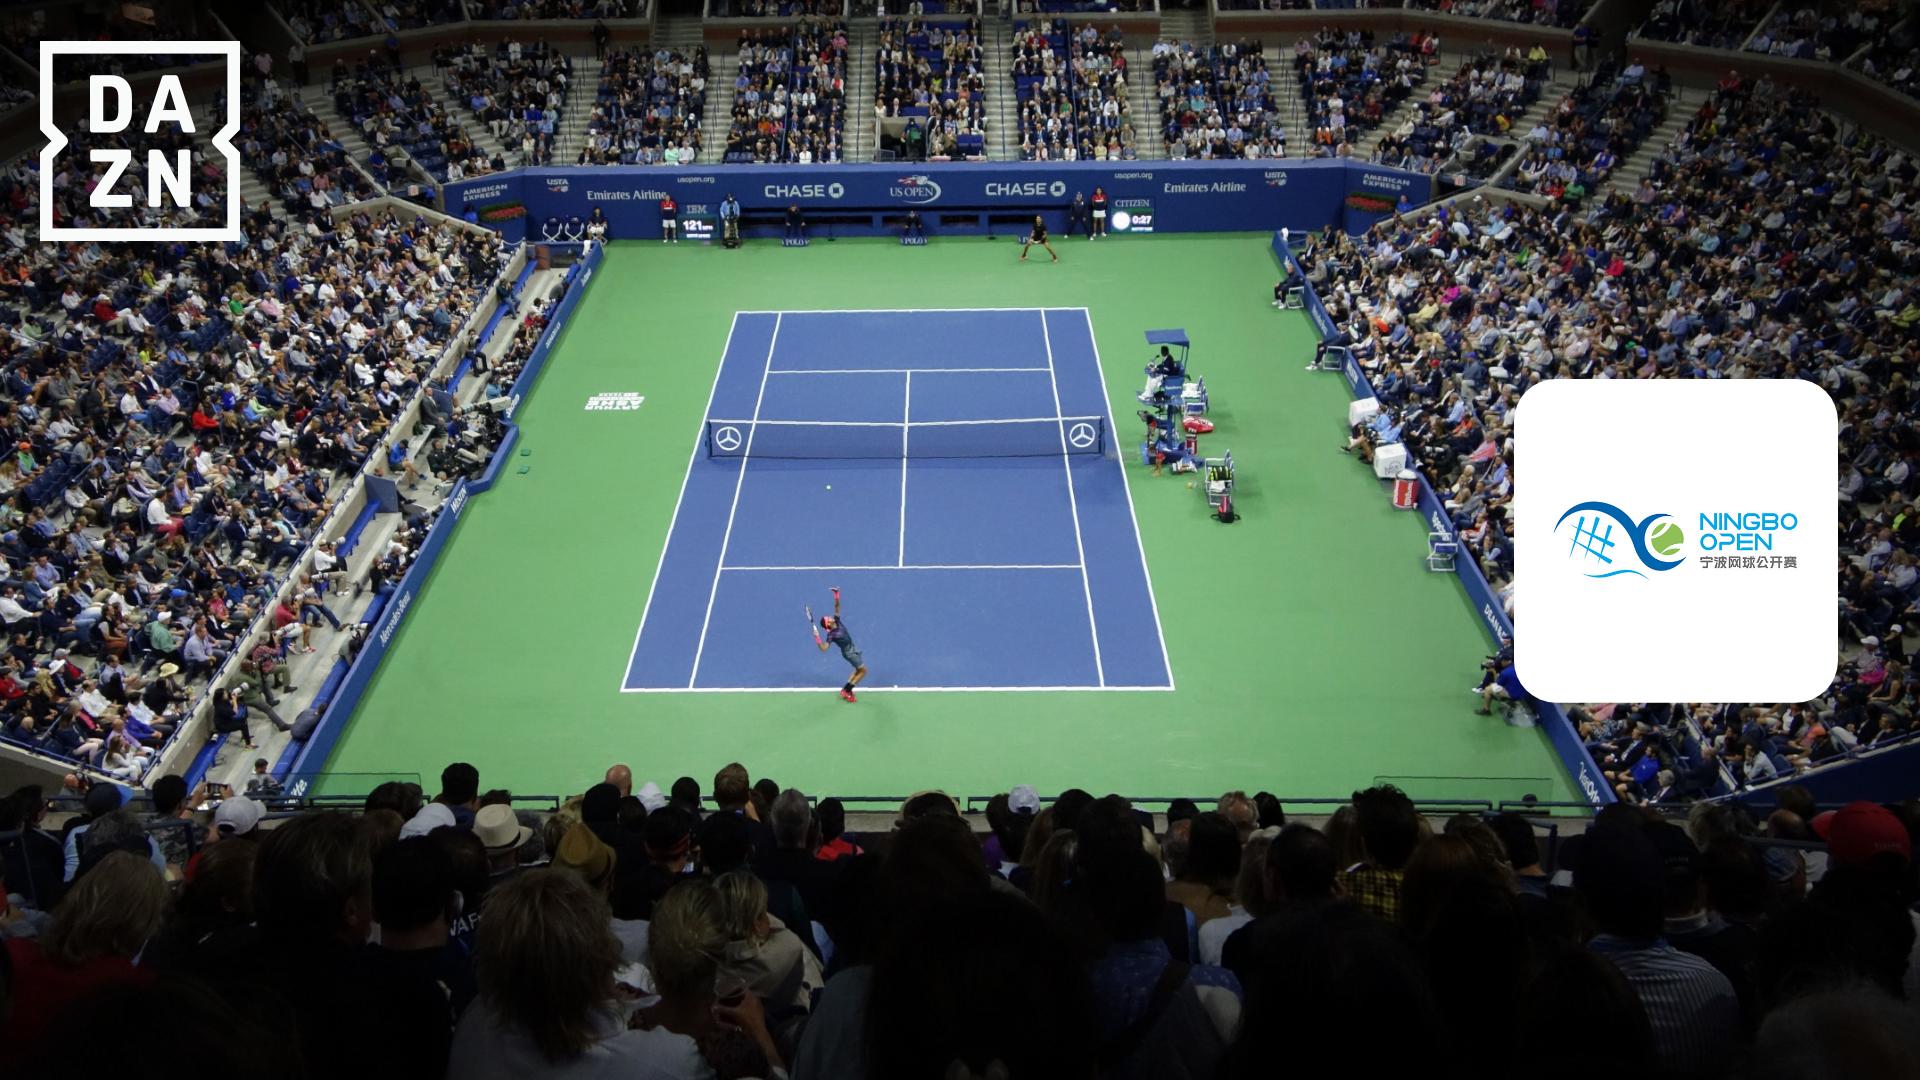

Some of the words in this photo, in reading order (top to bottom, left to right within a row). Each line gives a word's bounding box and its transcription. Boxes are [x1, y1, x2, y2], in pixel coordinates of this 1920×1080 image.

[677, 175, 715, 185] usopen.org
[1264, 171, 1288, 179] USTA
[1364, 173, 1410, 187] AMERICAN
[546, 178, 570, 186] USTA
[1163, 182, 1209, 194] Emirates
[1210, 181, 1247, 193] Airline
[1363, 179, 1402, 191] EXPRESS
[463, 183, 508, 197] AMERICAN
[764, 184, 826, 198] CHASE
[890, 187, 903, 197] US
[904, 187, 934, 197] OPEN
[985, 182, 1047, 196] CHASE
[463, 190, 501, 202] EXPRESS
[587, 190, 631, 201] Emirates
[686, 204, 708, 214] IBM
[1114, 199, 1150, 208] CITIZEN
[683, 219, 702, 231] 121
[1132, 215, 1152, 225] 0:27
